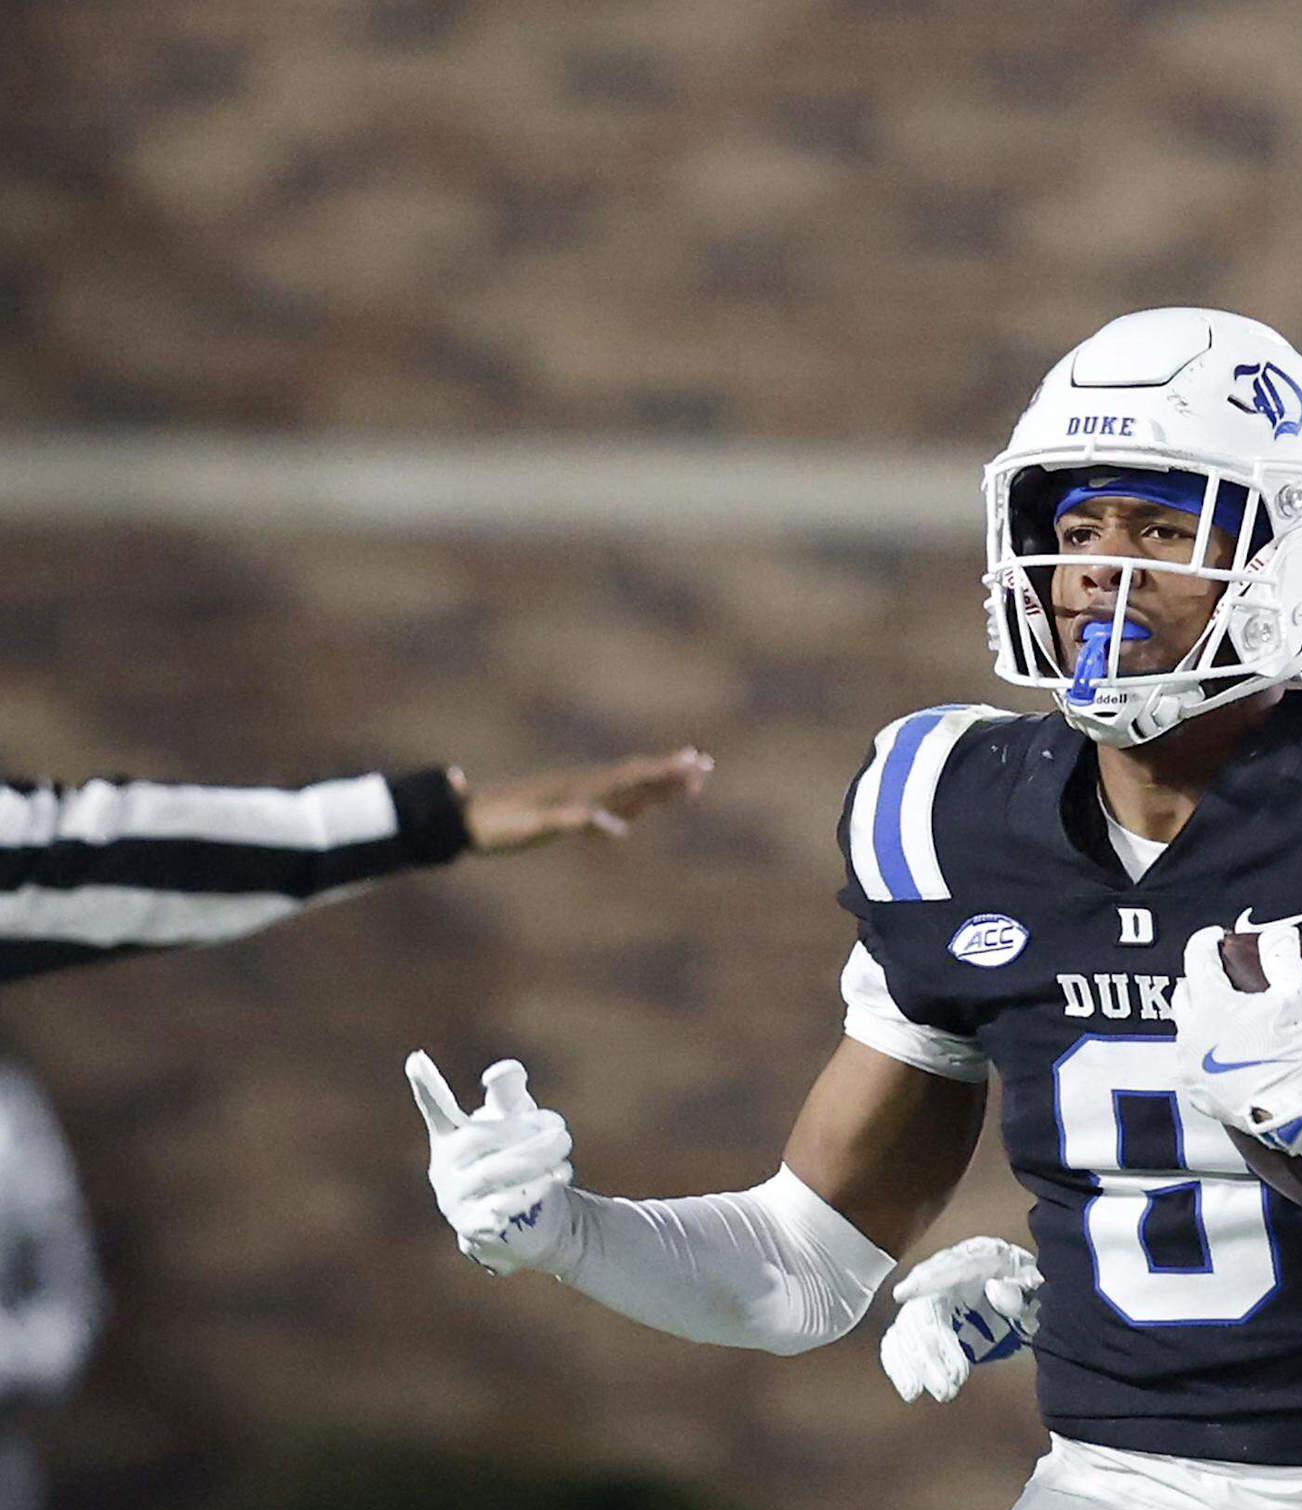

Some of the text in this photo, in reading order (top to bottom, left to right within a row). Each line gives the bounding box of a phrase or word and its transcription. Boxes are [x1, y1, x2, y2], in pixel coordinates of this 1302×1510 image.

[1065, 416, 1136, 437] DUKE
[964, 926, 1016, 951] ACC
[1117, 908, 1153, 943] D
[1056, 973, 1187, 1020] DUK
[1053, 1032, 1282, 1328] 8
